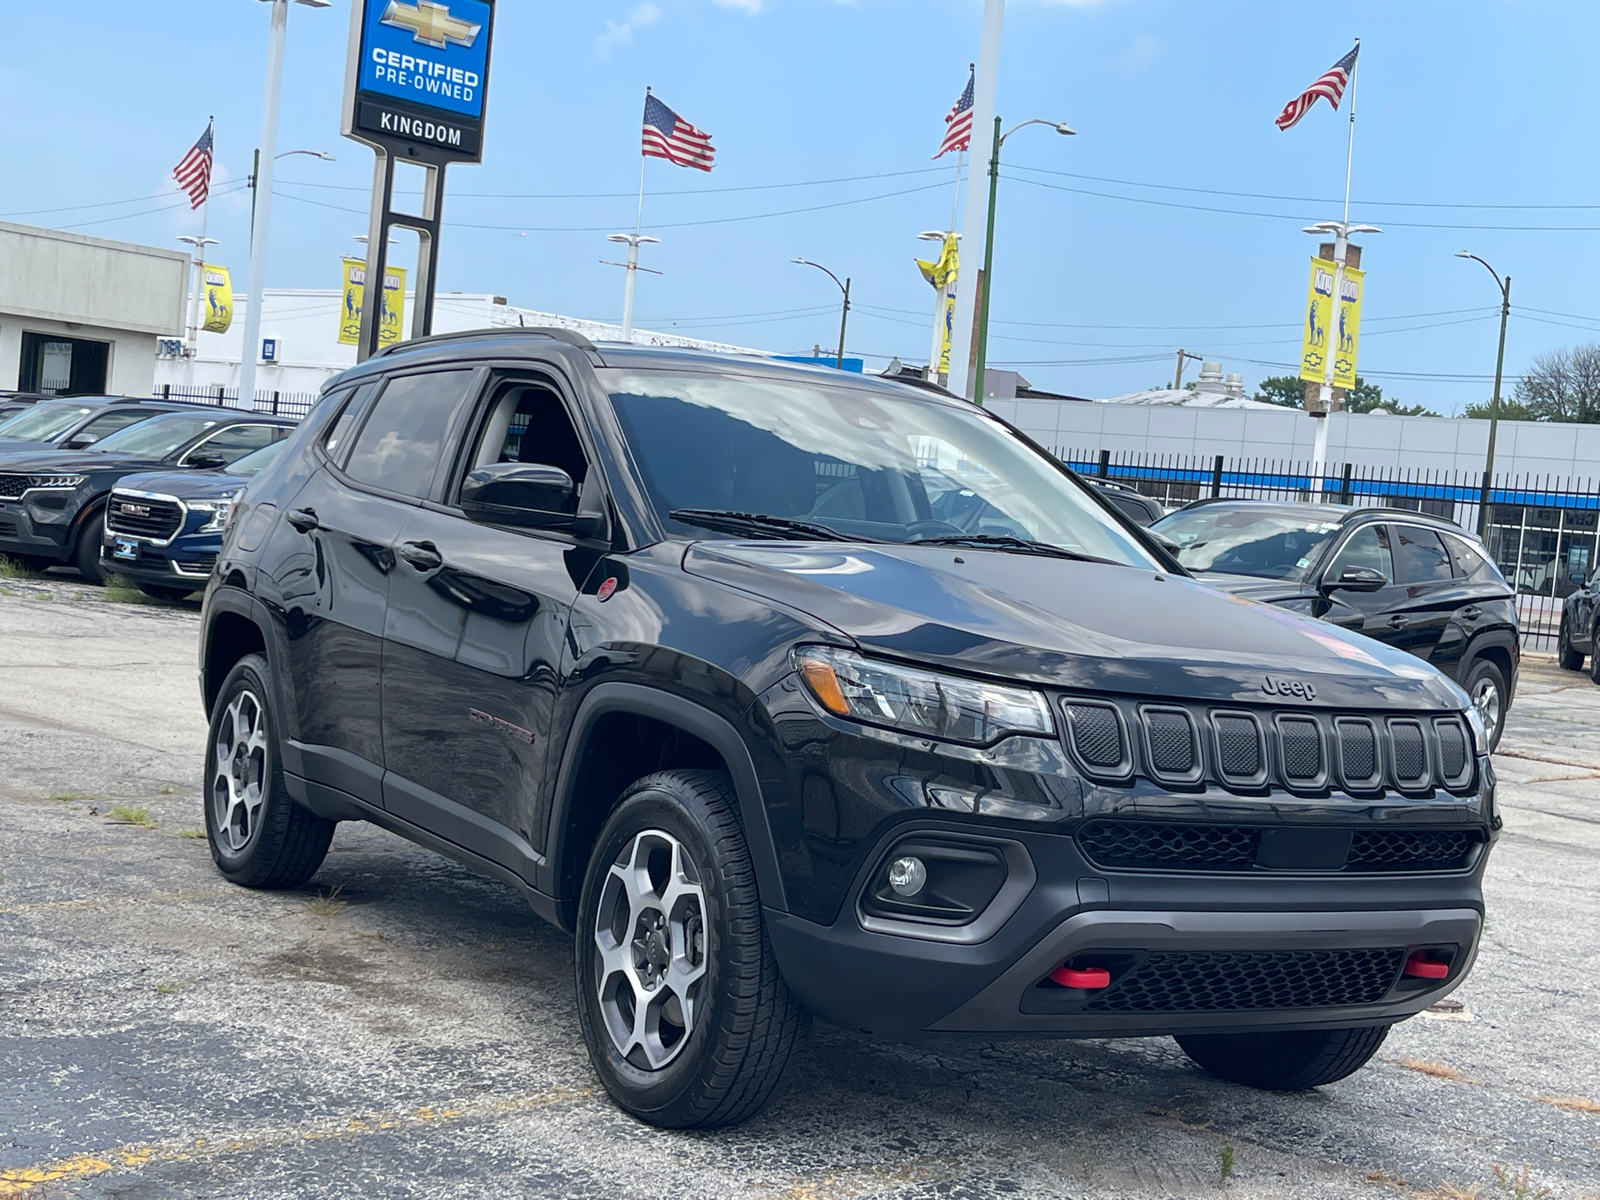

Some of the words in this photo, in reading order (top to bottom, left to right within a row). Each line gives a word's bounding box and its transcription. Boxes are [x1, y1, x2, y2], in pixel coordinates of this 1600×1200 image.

[372, 47, 479, 88] CERTIFIED
[375, 65, 473, 102] PRE-OWNED
[381, 112, 461, 146] KINGDOM
[205, 270, 225, 285] dom
[1314, 268, 1333, 296] King
[1341, 276, 1358, 301] dom
[121, 504, 150, 517] GMC
[1261, 676, 1317, 701] Jeep
